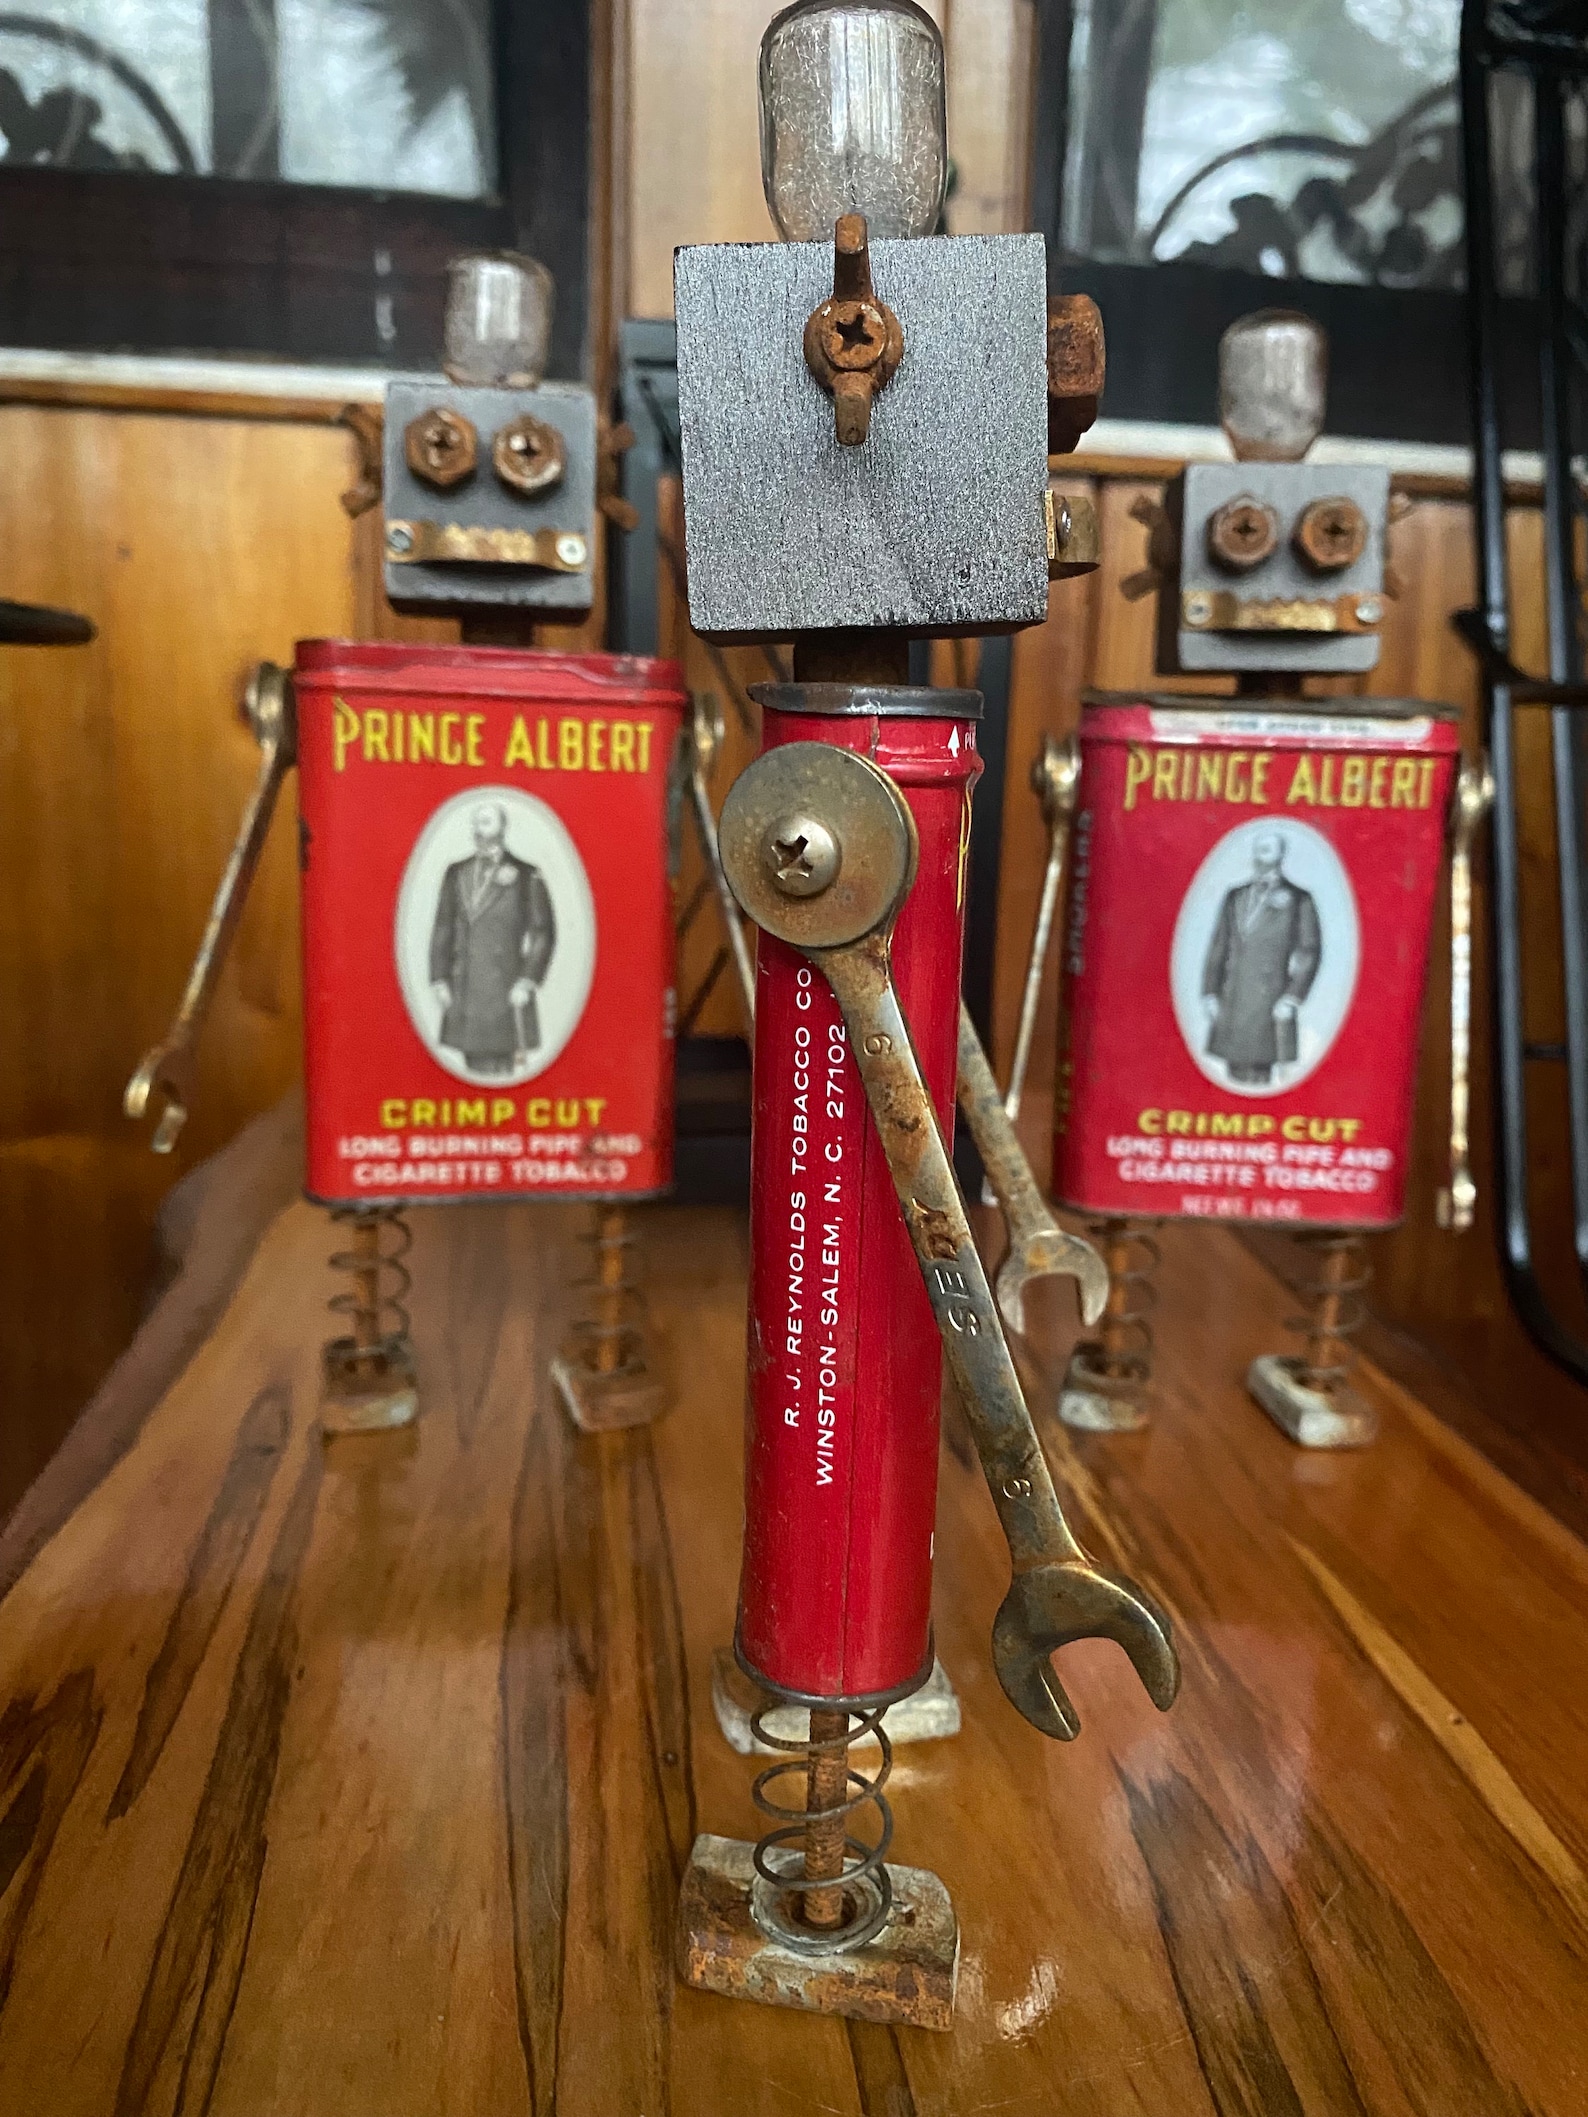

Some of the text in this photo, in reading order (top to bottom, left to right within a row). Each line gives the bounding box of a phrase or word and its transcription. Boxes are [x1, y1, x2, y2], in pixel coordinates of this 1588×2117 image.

[333, 696, 653, 772] PRINCE ALBERT
[1124, 746, 1435, 810] PRINCE ALBERT
[382, 1099, 605, 1127] CRIMP CUT
[792, 1027, 810, 1174] TOBACCO
[1138, 1108, 1360, 1142] CRIMP CUT
[339, 1136, 401, 1159] LONG
[408, 1134, 523, 1156] BURNING
[529, 1134, 582, 1155] PIPE
[1106, 1135, 1392, 1170] LONG BURNING PIPE AND
[353, 1161, 501, 1186] CIGARETTE
[1118, 1159, 1378, 1193] CIGARETTE TOBACCO
[817, 1025, 845, 1485] WINSTON-SALEM, N. C. 27102
[787, 1192, 805, 1354] REYNOLDS
[787, 1369, 800, 1389] J.
[785, 1403, 799, 1427] R.
